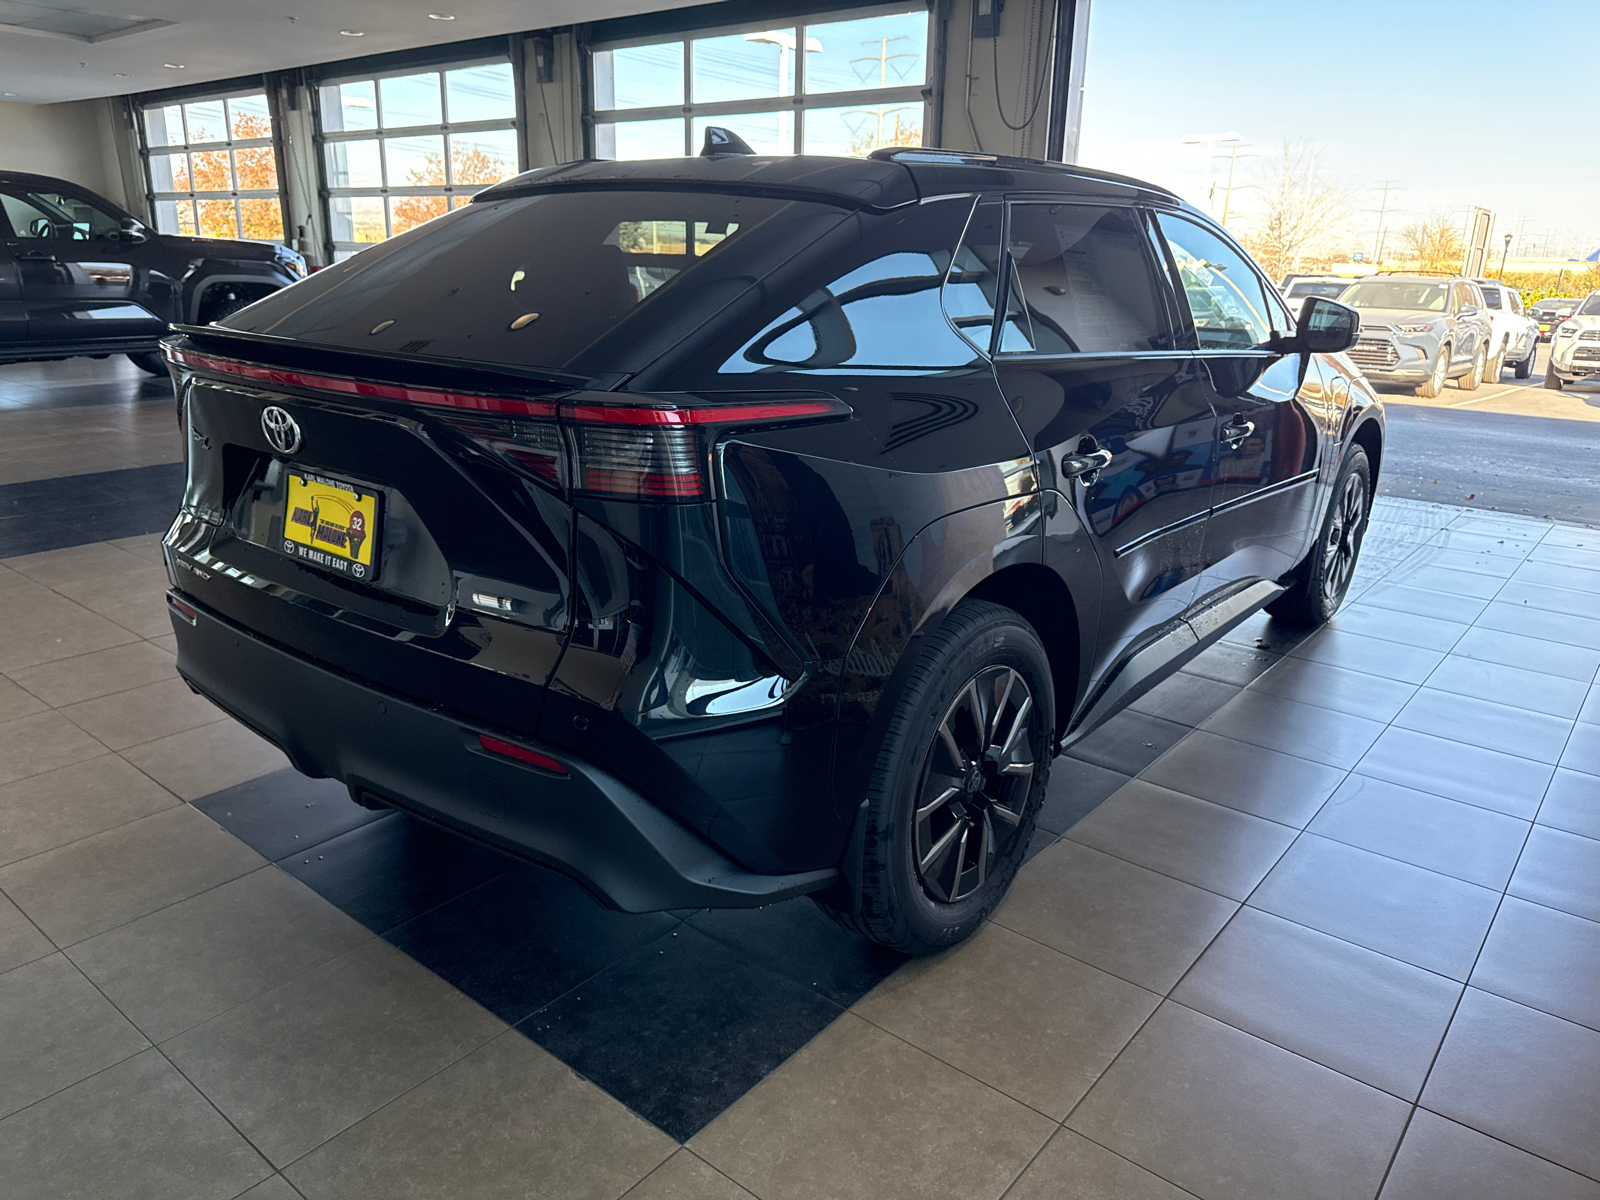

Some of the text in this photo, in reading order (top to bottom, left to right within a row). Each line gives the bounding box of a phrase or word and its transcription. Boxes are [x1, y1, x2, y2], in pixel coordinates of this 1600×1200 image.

[335, 481, 354, 493] TOYOTA
[291, 506, 313, 527] KARL
[352, 516, 363, 531] 32
[315, 524, 347, 549] MALONE
[298, 546, 348, 571] WE MAKE IT EASY
